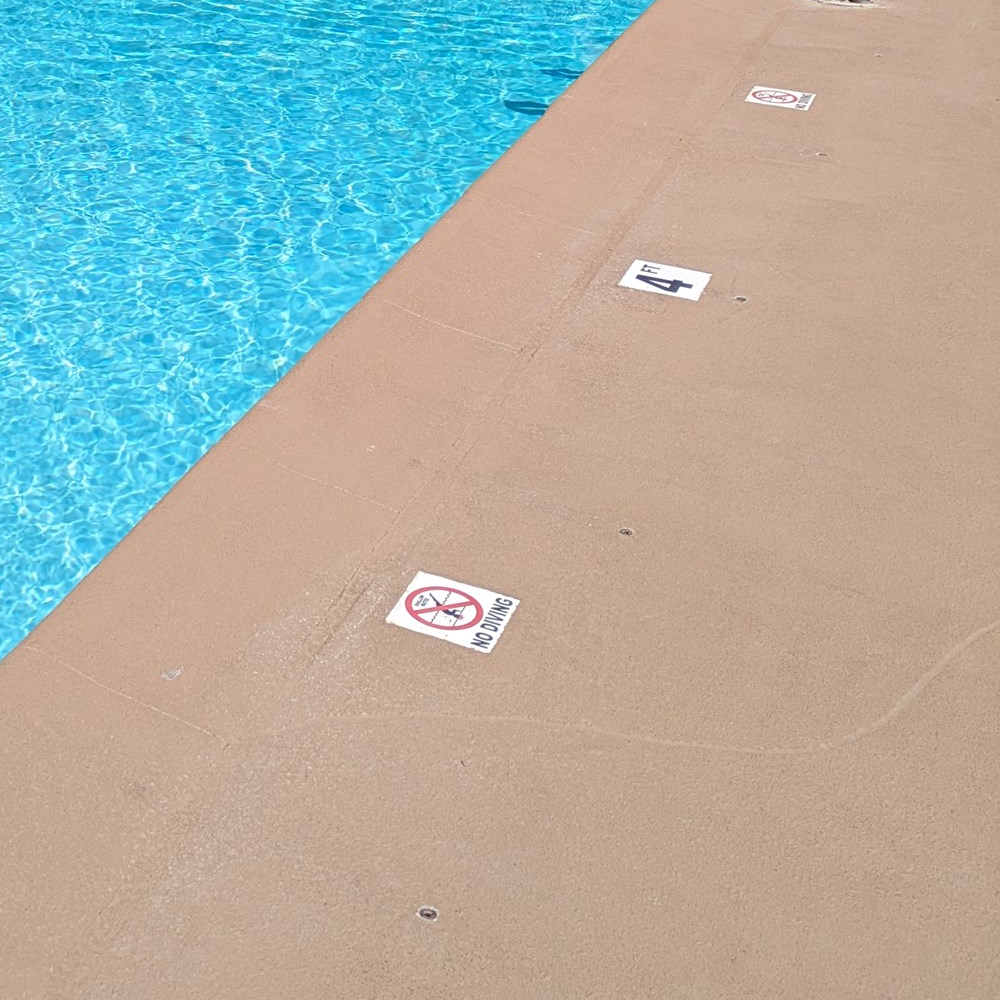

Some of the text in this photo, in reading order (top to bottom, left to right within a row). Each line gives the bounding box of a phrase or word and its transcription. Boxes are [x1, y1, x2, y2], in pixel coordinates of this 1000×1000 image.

[636, 264, 693, 293] 4 FT
[470, 597, 513, 649] NO DIVING
